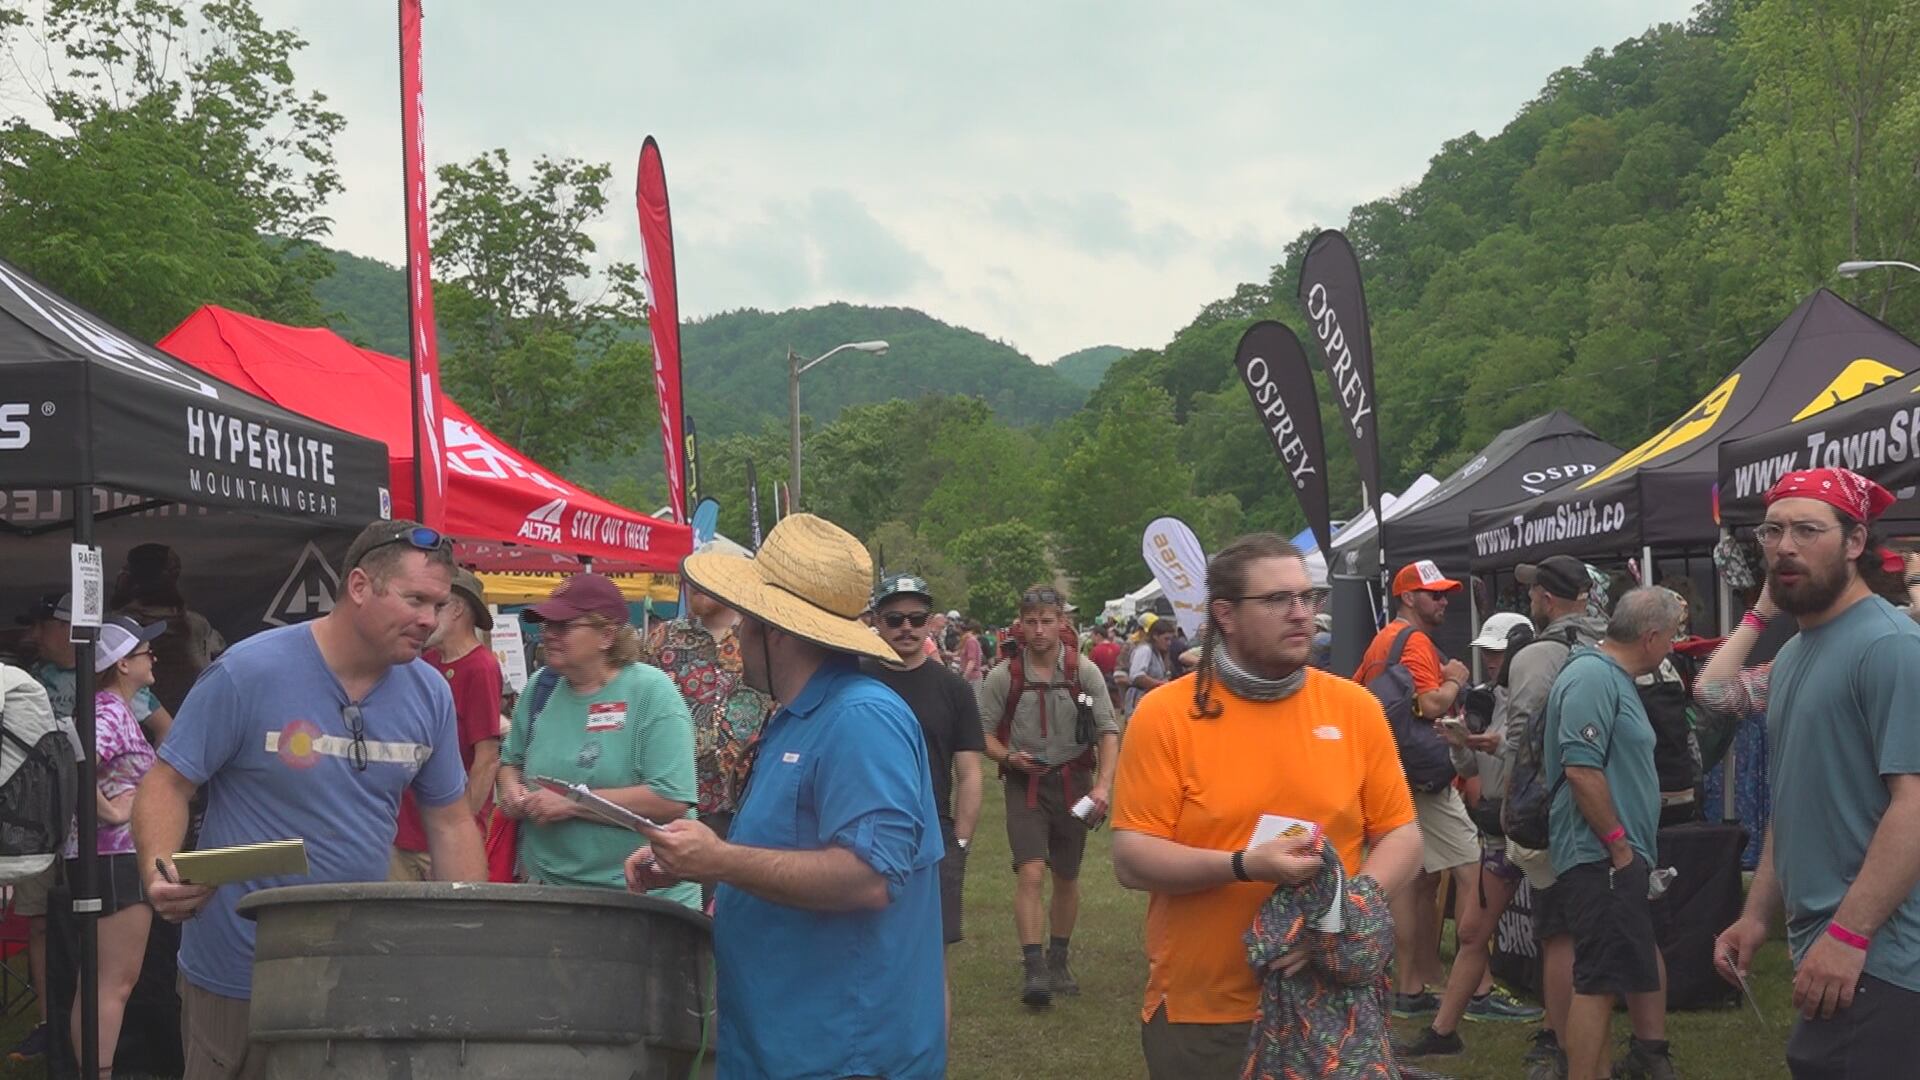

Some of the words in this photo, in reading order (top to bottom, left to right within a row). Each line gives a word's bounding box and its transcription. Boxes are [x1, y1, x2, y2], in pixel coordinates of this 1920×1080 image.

[1307, 283, 1372, 430] OSPREY
[1246, 357, 1317, 481] OSPREY
[187, 406, 336, 485] HYPERLITE
[189, 468, 291, 508] MOUNTAIN
[297, 490, 337, 516] GEAR
[517, 520, 562, 544] ALTRA
[571, 510, 601, 542] STAY
[601, 516, 623, 547] OUT
[624, 522, 652, 551] THERE
[1475, 500, 1625, 556] www.TownShirt.co
[1498, 910, 1537, 958] SHIR
